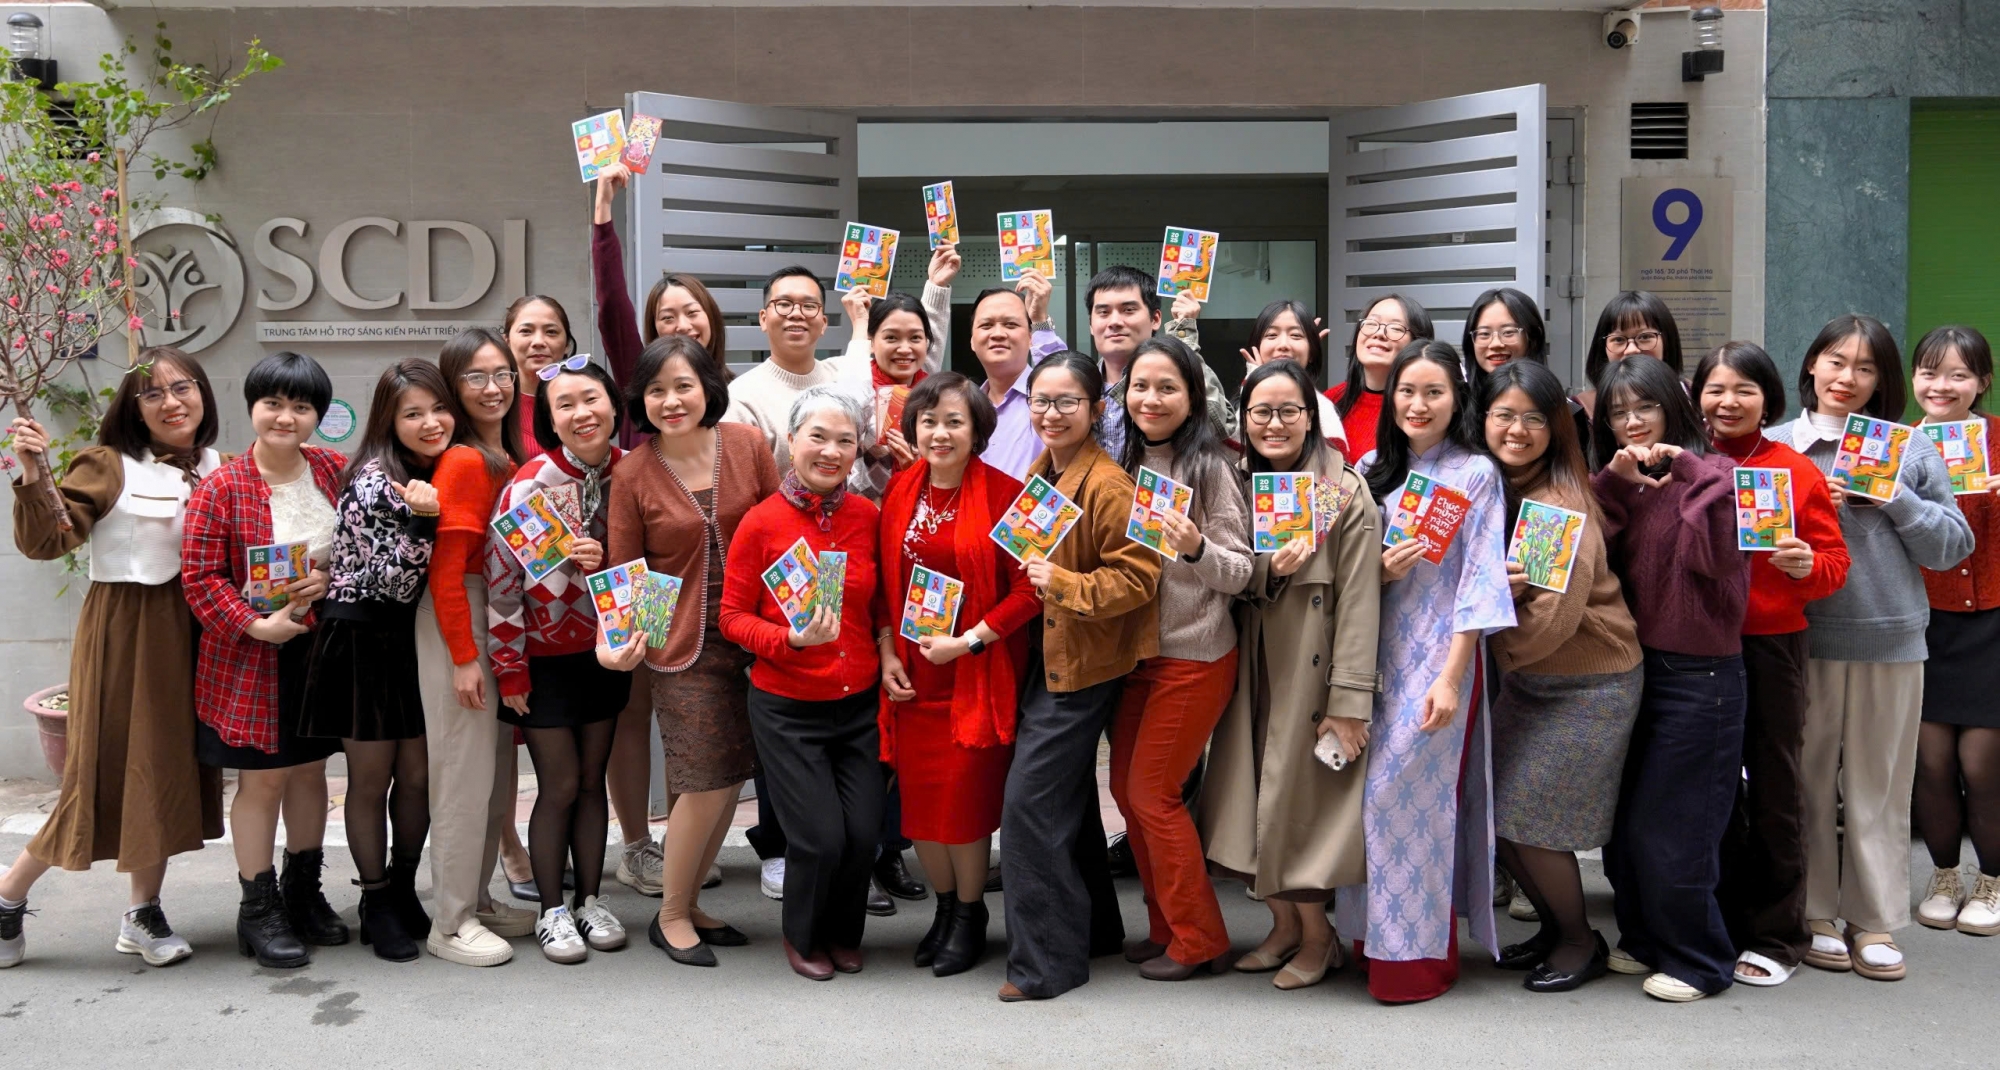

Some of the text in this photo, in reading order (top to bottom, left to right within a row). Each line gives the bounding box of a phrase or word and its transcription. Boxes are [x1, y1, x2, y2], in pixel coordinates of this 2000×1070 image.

[1652, 188, 1703, 261] 9
[254, 217, 528, 311] SCDI
[264, 328, 296, 336] TRUNG
[298, 327, 318, 336] TÂM
[320, 325, 334, 336] HỖ
[336, 328, 355, 337] TRỢ
[358, 326, 382, 336] SÁNG
[385, 325, 406, 336] KIẾN
[408, 326, 431, 335] PHÁT
[434, 325, 460, 336] TRIỂN
[1036, 482, 1044, 491] 20
[1031, 487, 1041, 496] 25
[500, 520, 510, 528] 20
[503, 524, 513, 532] 25
